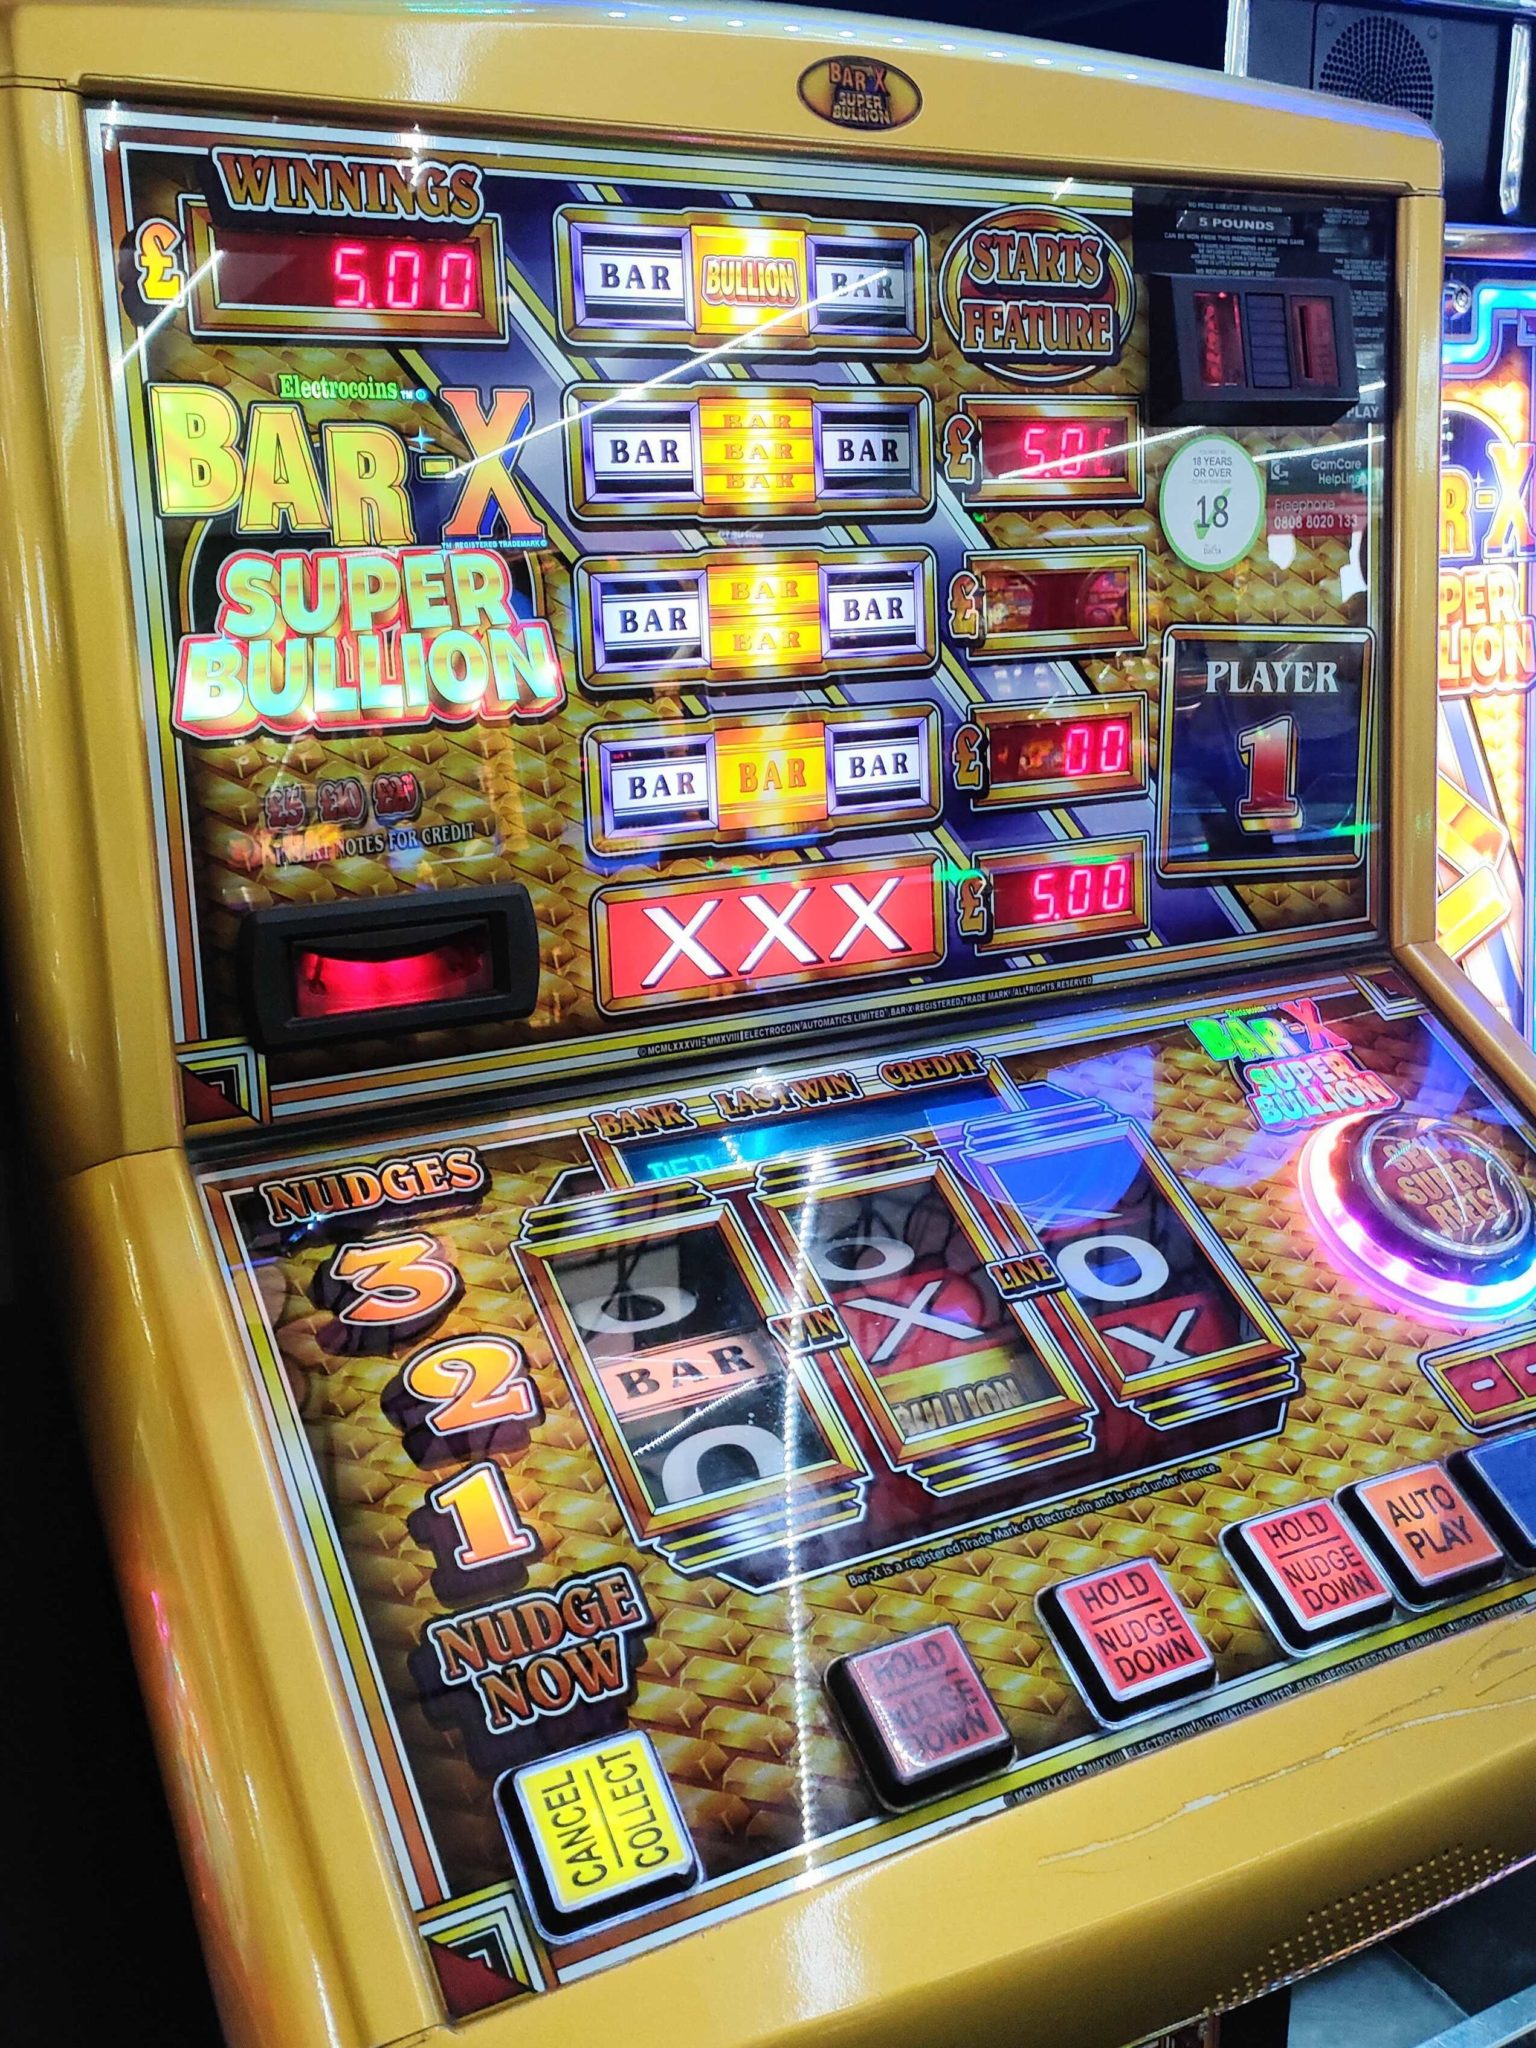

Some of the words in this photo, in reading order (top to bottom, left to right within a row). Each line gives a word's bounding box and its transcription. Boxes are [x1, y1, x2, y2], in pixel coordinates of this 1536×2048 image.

[832, 105, 891, 124] BULLION
[839, 92, 882, 109] SUPER
[216, 152, 480, 219] WINNINGS
[1200, 217, 1208, 227] 5
[1212, 218, 1275, 231] POUNDS
[139, 221, 181, 301] £
[333, 246, 475, 310] 5.00
[600, 263, 672, 291] BAR
[704, 256, 797, 304] BULLION
[830, 273, 895, 301] BAR
[969, 233, 1103, 285] STARTS
[962, 303, 1113, 353] FEATURE
[278, 374, 398, 400] Electrocoins
[149, 386, 546, 546] BAR-X
[610, 438, 681, 465] BAR
[837, 439, 900, 464] BAR
[724, 442, 794, 461] BAR
[948, 418, 974, 480] £
[1193, 468, 1206, 478] OR
[1208, 468, 1232, 478] OVER
[1204, 457, 1233, 467] YEARS
[1311, 458, 1362, 471] GamCare
[1196, 495, 1229, 528] 18
[1274, 515, 1303, 530] 0808
[1306, 514, 1335, 529] 8020
[221, 552, 512, 640] SUPER
[731, 581, 799, 601] BAR
[951, 575, 978, 635] £
[619, 608, 688, 634] BAR
[843, 597, 905, 622] BAR
[178, 625, 562, 724] BULLION
[1205, 660, 1340, 694] PLAYER
[628, 772, 696, 801] BAR
[739, 758, 808, 794] BAR
[849, 752, 909, 779] BAR
[955, 726, 982, 786] £
[1239, 715, 1300, 828] 1
[336, 833, 385, 858] NOTES
[389, 829, 417, 850] FOR
[421, 822, 475, 846] CREDIT
[958, 877, 986, 932] £
[1032, 863, 1127, 922] 5.00
[744, 1022, 801, 1041] ELECTROCOIN
[801, 1013, 853, 1031] AUTOMATICS
[914, 997, 960, 1013] REGISTERED
[962, 992, 986, 1006] TRADE
[1029, 981, 1055, 996] RIGHTS
[1056, 976, 1093, 991] RESERVED
[1187, 998, 1351, 1061] BAR-X
[880, 1050, 983, 1087] CREDIT
[1250, 1051, 1358, 1095] SUPER
[712, 1085, 790, 1118] LAST
[796, 1073, 856, 1106] WIN
[1253, 1074, 1395, 1125] BULLION
[594, 1103, 688, 1139] BANK
[265, 1151, 481, 1223] NUDGES
[1397, 1159, 1486, 1205] SUPER
[332, 1236, 457, 1325] 3
[988, 1254, 1056, 1290] LINE
[774, 1306, 842, 1347] WIN
[406, 1337, 535, 1436] 2
[615, 1344, 755, 1400] BAR
[436, 1464, 533, 1567] 1
[848, 1565, 881, 1587] Bar-X
[883, 1562, 893, 1576] is
[895, 1561, 903, 1572] a
[905, 1543, 961, 1569] registered
[961, 1532, 992, 1551] Trade
[994, 1522, 1020, 1541] Mark
[1022, 1518, 1033, 1532] of
[1034, 1501, 1094, 1528] Electrocoin
[1094, 1494, 1116, 1510] and
[1115, 1489, 1125, 1503] is
[1125, 1482, 1150, 1499] used
[1151, 1474, 1179, 1492] under
[1180, 1463, 1221, 1484] licence.
[1264, 1511, 1329, 1550] HOLD
[1385, 1484, 1456, 1529] AUTO
[1405, 1515, 1474, 1560] PLAY
[1280, 1545, 1362, 1589] NUDGE
[1301, 1569, 1376, 1613] DOWN
[1079, 1570, 1150, 1614] HOLD
[435, 1573, 640, 1680] NUDGE
[1094, 1606, 1185, 1657] NUDGE
[480, 1635, 625, 1727] NOW
[869, 1639, 947, 1687] HOLD
[1114, 1634, 1195, 1683] DOWN
[1128, 1723, 1196, 1758] ELECTROCOIN
[1196, 1698, 1254, 1732] AUTOMATICS
[1324, 1654, 1378, 1681] REGISTERED
[541, 1769, 608, 1888] CANCEL
[598, 1749, 670, 1871] COLLECT
